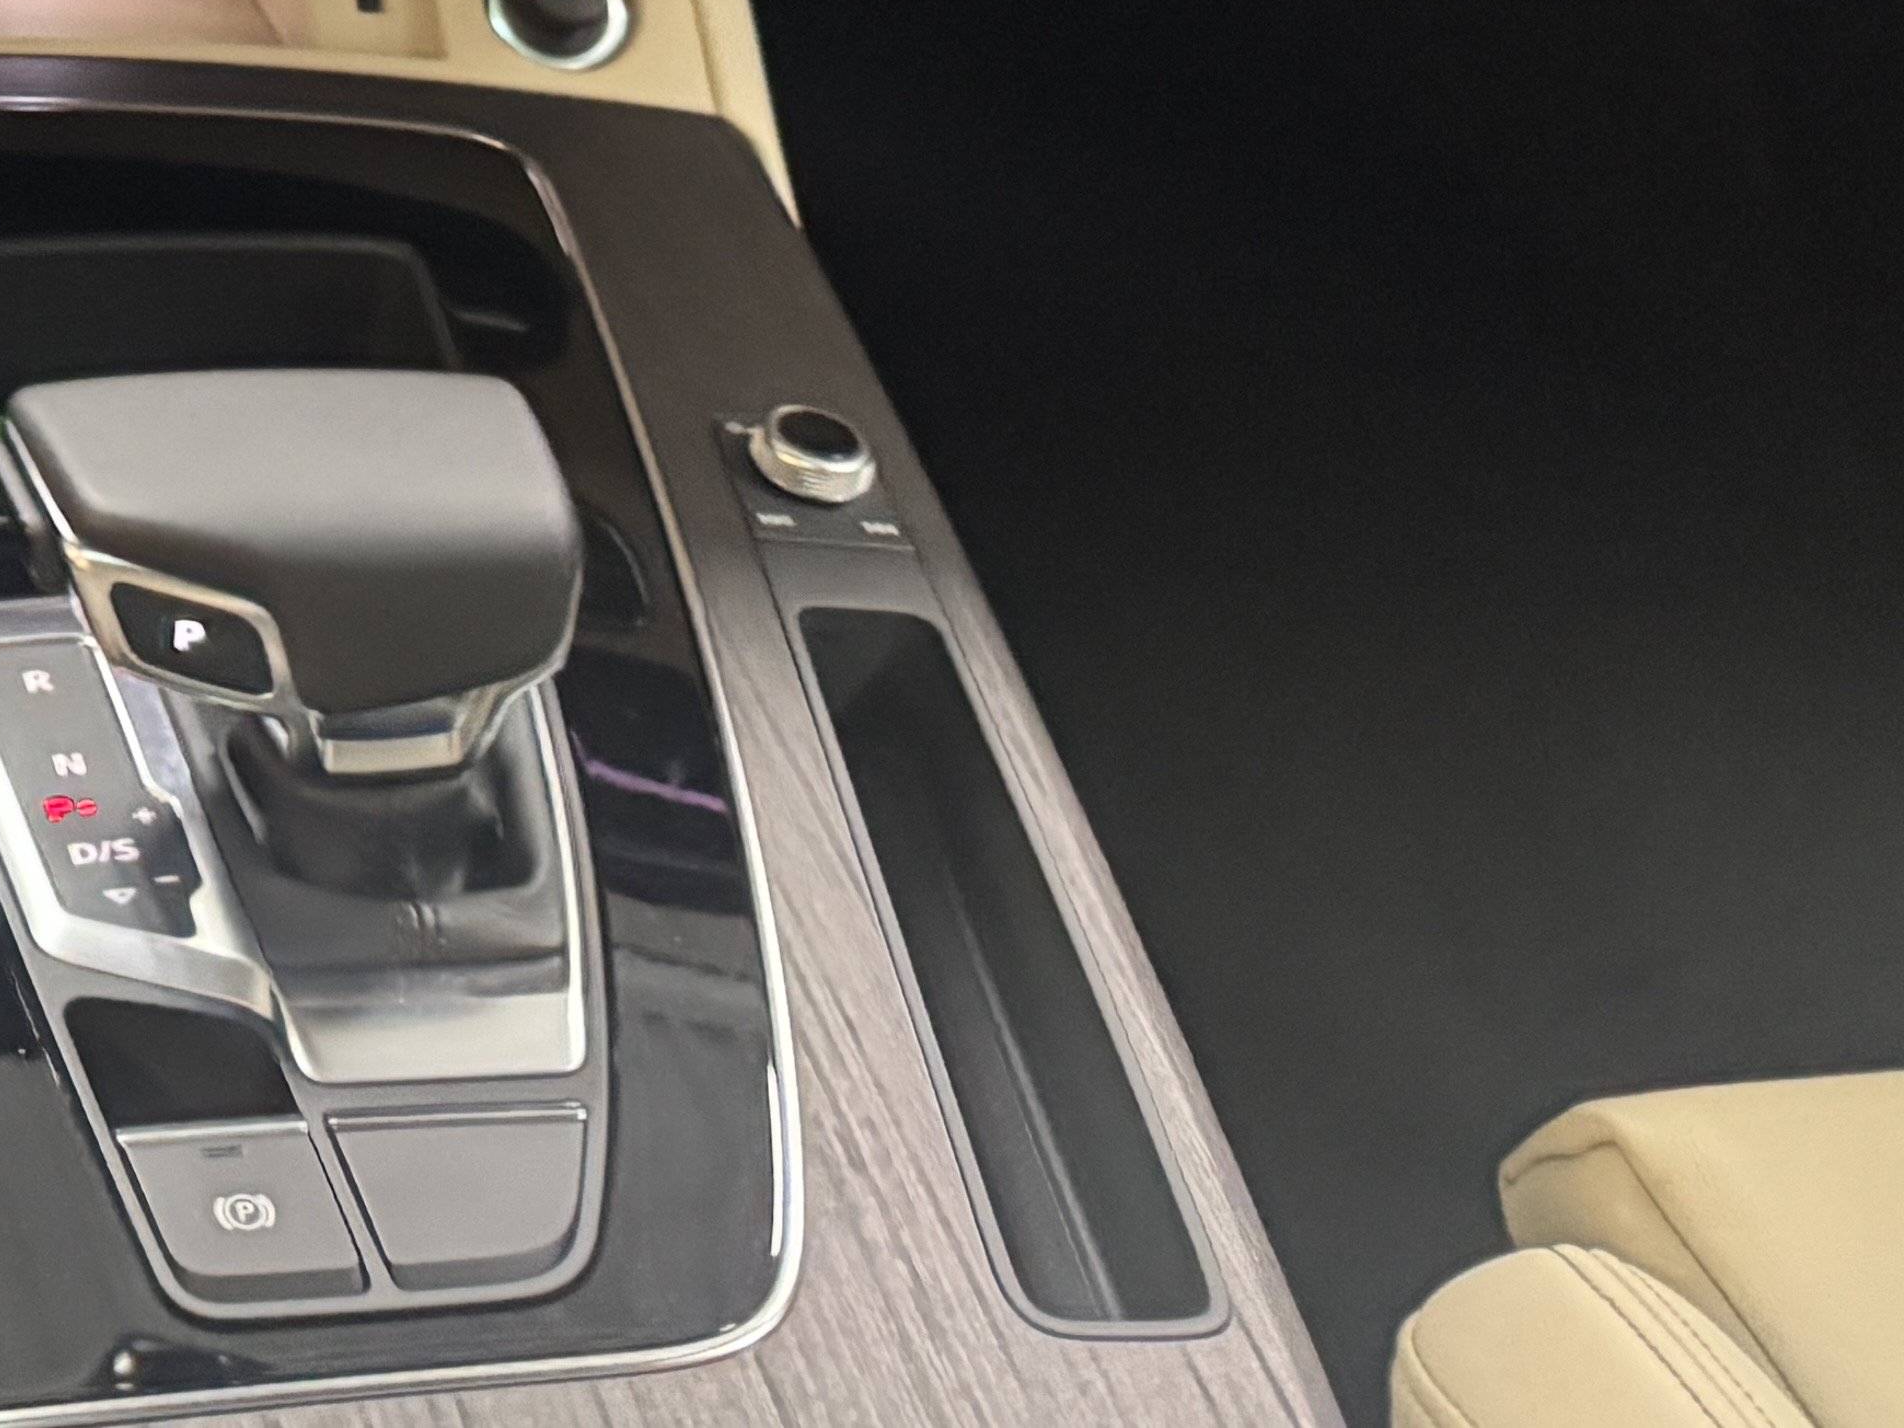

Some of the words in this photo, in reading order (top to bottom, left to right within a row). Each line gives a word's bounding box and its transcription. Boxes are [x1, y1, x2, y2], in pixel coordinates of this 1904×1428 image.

[173, 619, 205, 651] P
[22, 669, 55, 693] R
[52, 752, 87, 777] N
[67, 837, 140, 866] D/S
